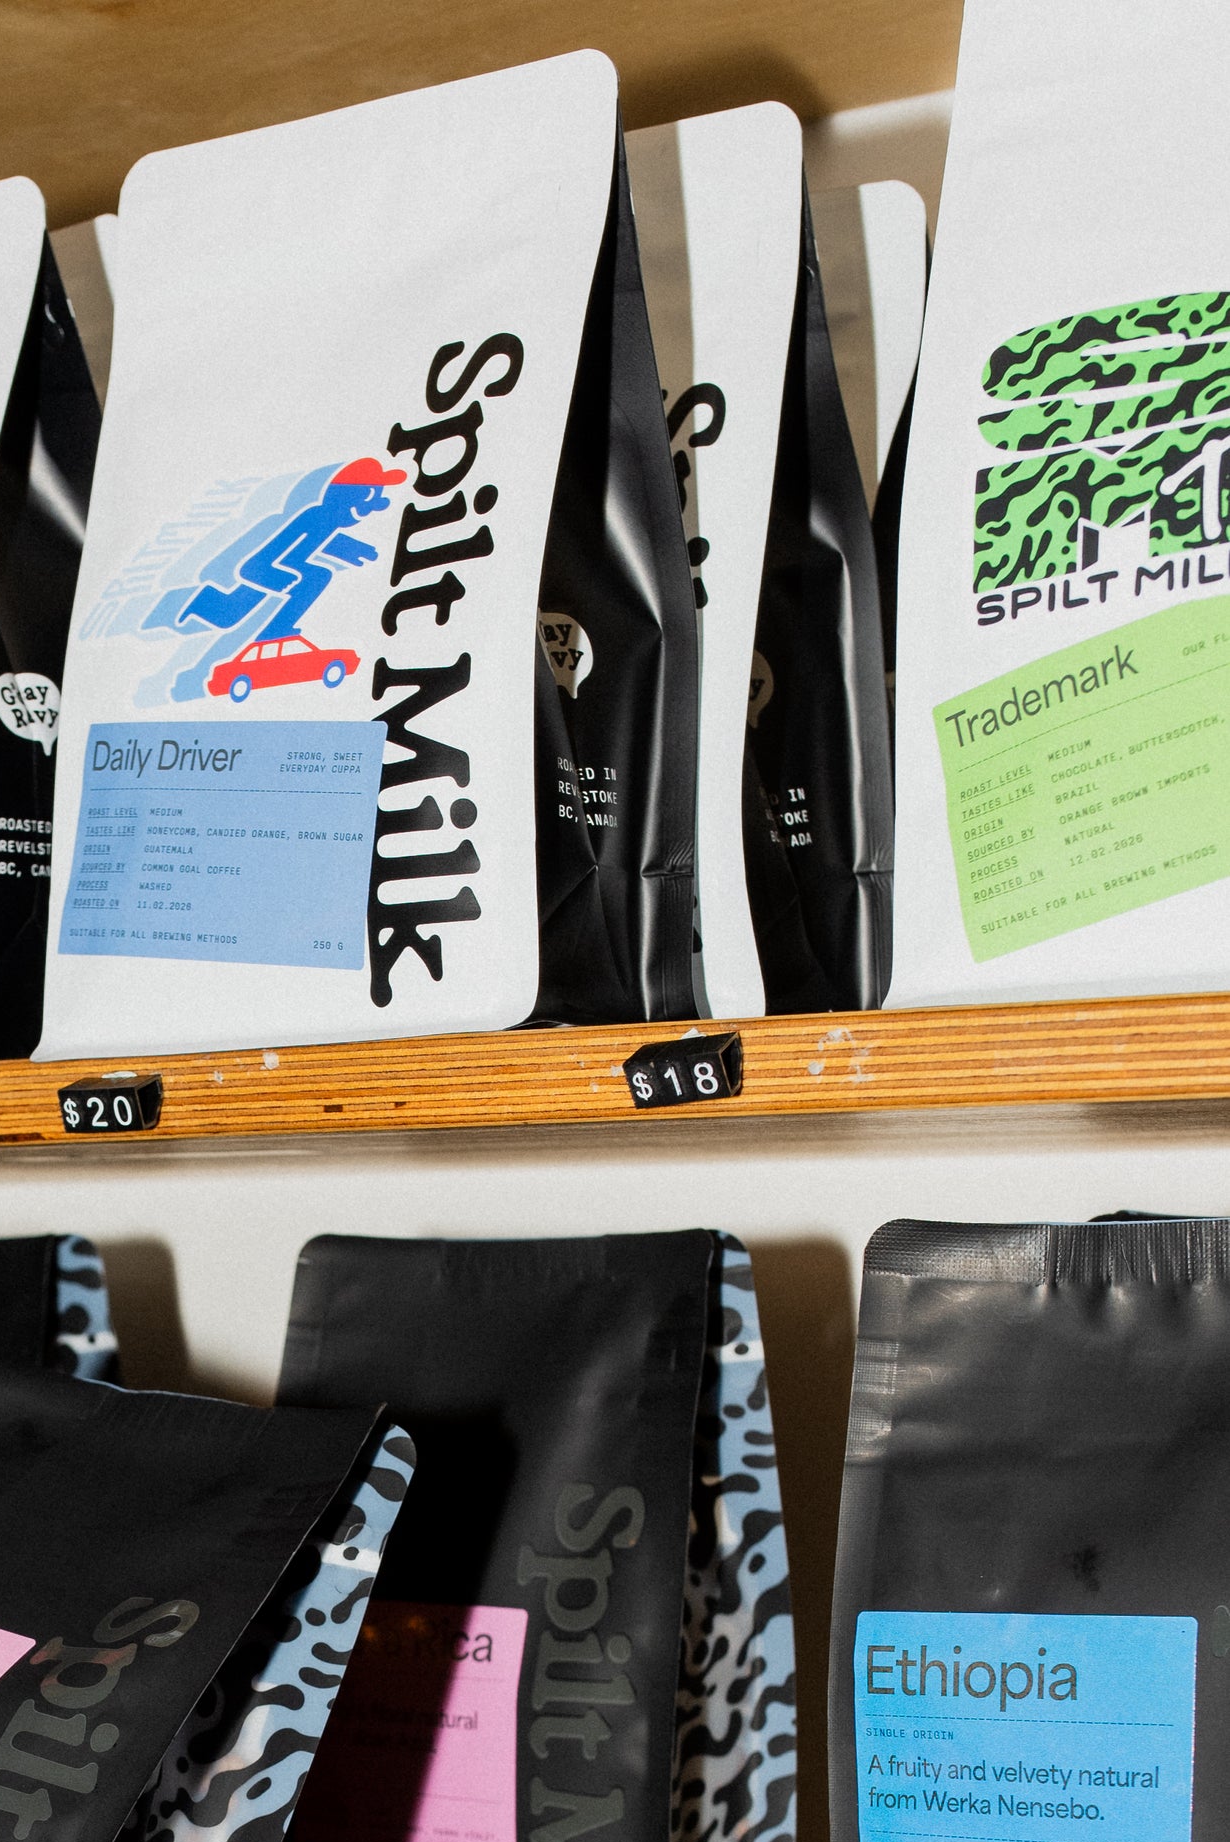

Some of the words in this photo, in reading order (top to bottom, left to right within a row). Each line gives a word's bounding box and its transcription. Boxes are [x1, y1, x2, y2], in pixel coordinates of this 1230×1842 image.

[381, 332, 523, 638] Spilt
[977, 571, 1118, 625] SPILT
[945, 645, 1139, 748] Trademark
[287, 752, 325, 762] STRONG,
[334, 753, 362, 762] SWEET
[1048, 740, 1092, 762] MEDIUM
[1051, 752, 1123, 783] CHOCOLATE,
[1129, 716, 1225, 755] BUTTERSCOTCH,
[93, 739, 152, 778] Daily
[157, 739, 241, 772] Driver
[280, 764, 326, 774] EVERYDAY
[332, 765, 361, 774] CUPPA
[604, 768, 617, 781] IN
[1055, 782, 1099, 805] BRAZIL
[150, 808, 183, 816] MEDIUM
[559, 804, 578, 822] BC,
[0, 818, 52, 834] ROASTED
[147, 827, 200, 837] HONEYCOMB,
[207, 828, 246, 838] CANDIED
[252, 830, 291, 840] ORANGE,
[298, 831, 327, 840] BROWN
[333, 833, 363, 842] SUGAR
[368, 653, 481, 1008] Milk
[0, 840, 51, 855] REVELST
[144, 845, 193, 854] GUATEMALA
[0, 862, 21, 876] BC,
[142, 864, 174, 872] COMMON
[179, 865, 200, 874] GOAL
[207, 866, 241, 875] COFFEE
[139, 882, 172, 890] WASHED
[137, 901, 192, 910] 11.02.2026
[70, 928, 106, 938] SUITABLE
[110, 929, 125, 938] FOR
[131, 930, 146, 939] ALL
[153, 931, 191, 941] BREWING
[197, 934, 237, 944] METHODS
[313, 941, 332, 950] 250
[337, 942, 343, 950] G
[631, 1057, 720, 1101] $18
[64, 1096, 132, 1127] $20
[518, 1483, 645, 1760] Spilt
[866, 1645, 1077, 1712] Ethiopia
[866, 1728, 905, 1738] SINGLE
[913, 1730, 954, 1740] ORIGIN
[868, 1755, 883, 1775] A
[889, 1757, 942, 1784] fruity
[948, 1760, 986, 1781] and
[992, 1761, 1071, 1790] velvety
[1078, 1766, 1159, 1789] natural
[869, 1787, 916, 1810] from
[923, 1790, 991, 1815] Werka
[998, 1794, 1104, 1820] Nensebo.
